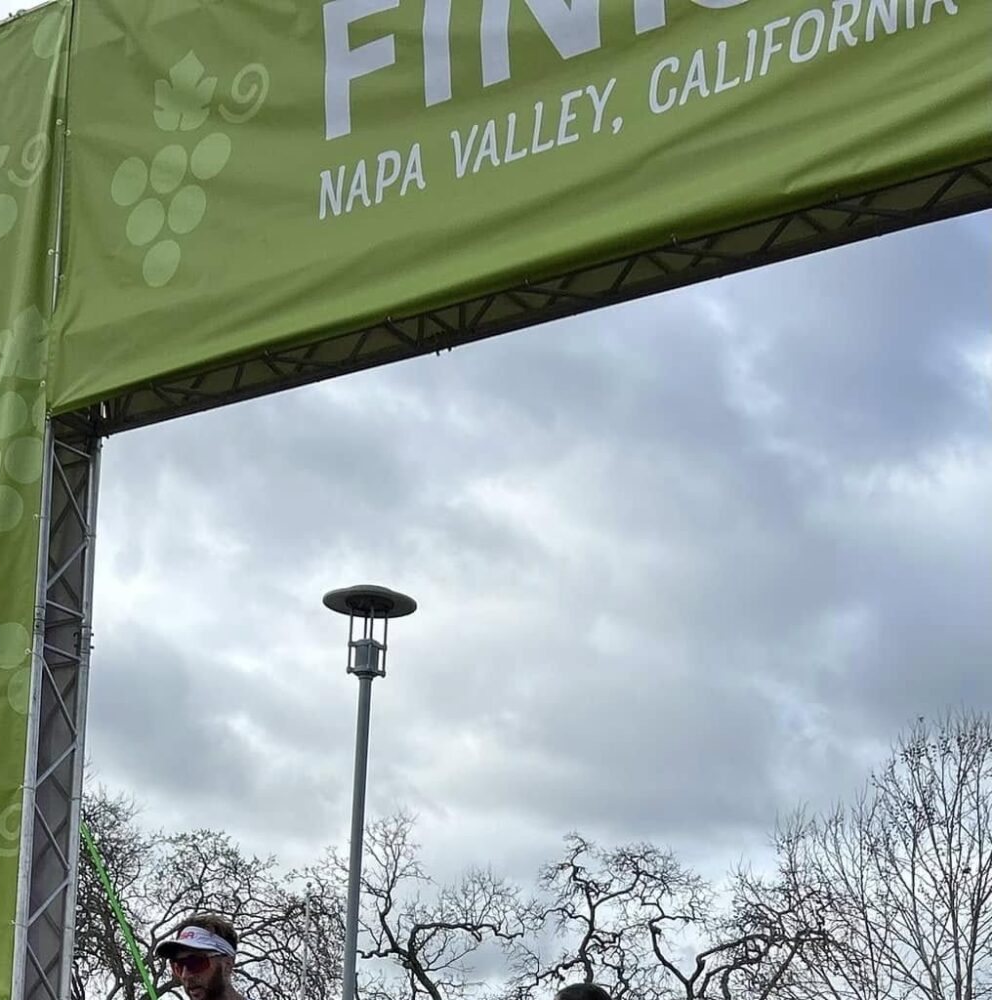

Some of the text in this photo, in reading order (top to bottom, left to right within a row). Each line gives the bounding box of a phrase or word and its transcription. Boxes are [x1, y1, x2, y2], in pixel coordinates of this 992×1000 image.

[324, 0, 748, 140] FIN
[318, 142, 425, 220] NAPA
[450, 78, 623, 179] VALLEY,
